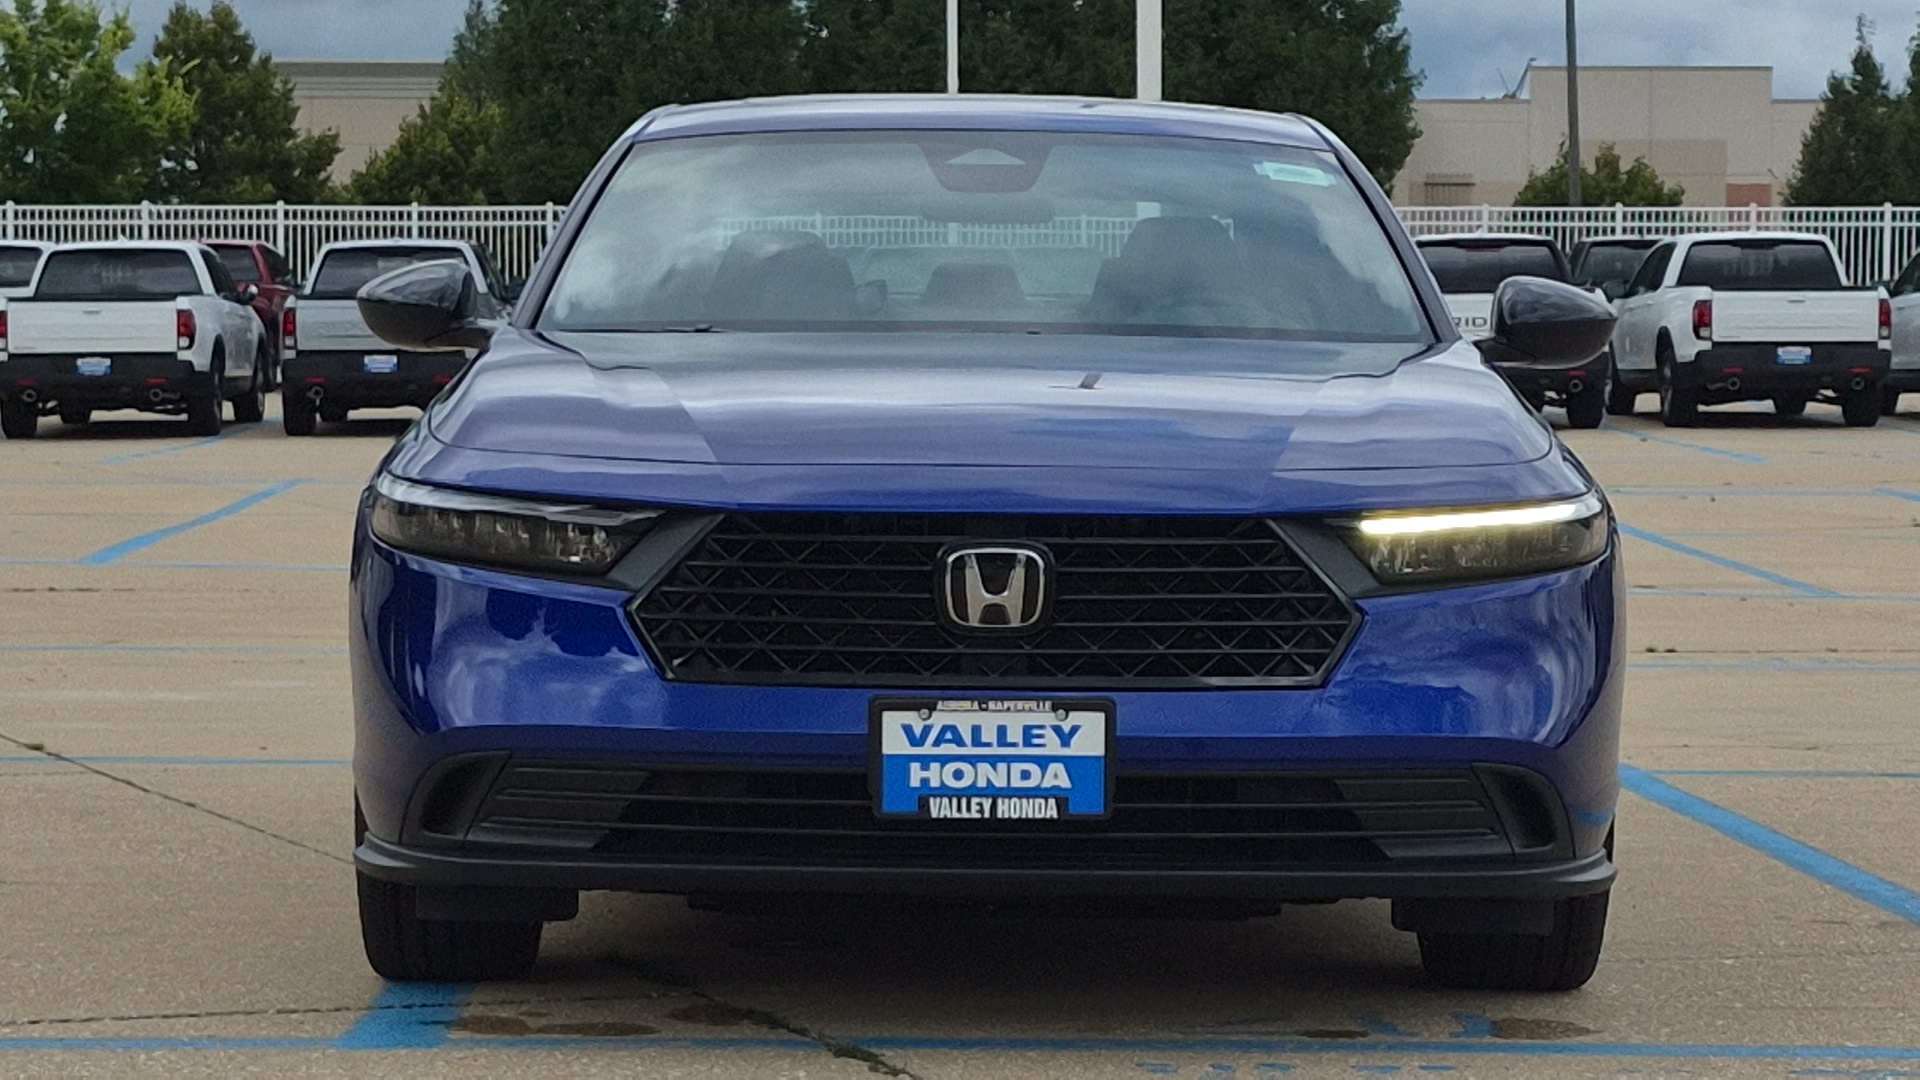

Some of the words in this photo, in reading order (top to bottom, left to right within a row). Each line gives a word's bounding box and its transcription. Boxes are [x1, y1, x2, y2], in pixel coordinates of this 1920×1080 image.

[901, 723, 1082, 748] VALLEY
[909, 762, 1072, 788] HONDA
[929, 796, 992, 818] VALLEY
[996, 797, 1058, 819] HONDA
